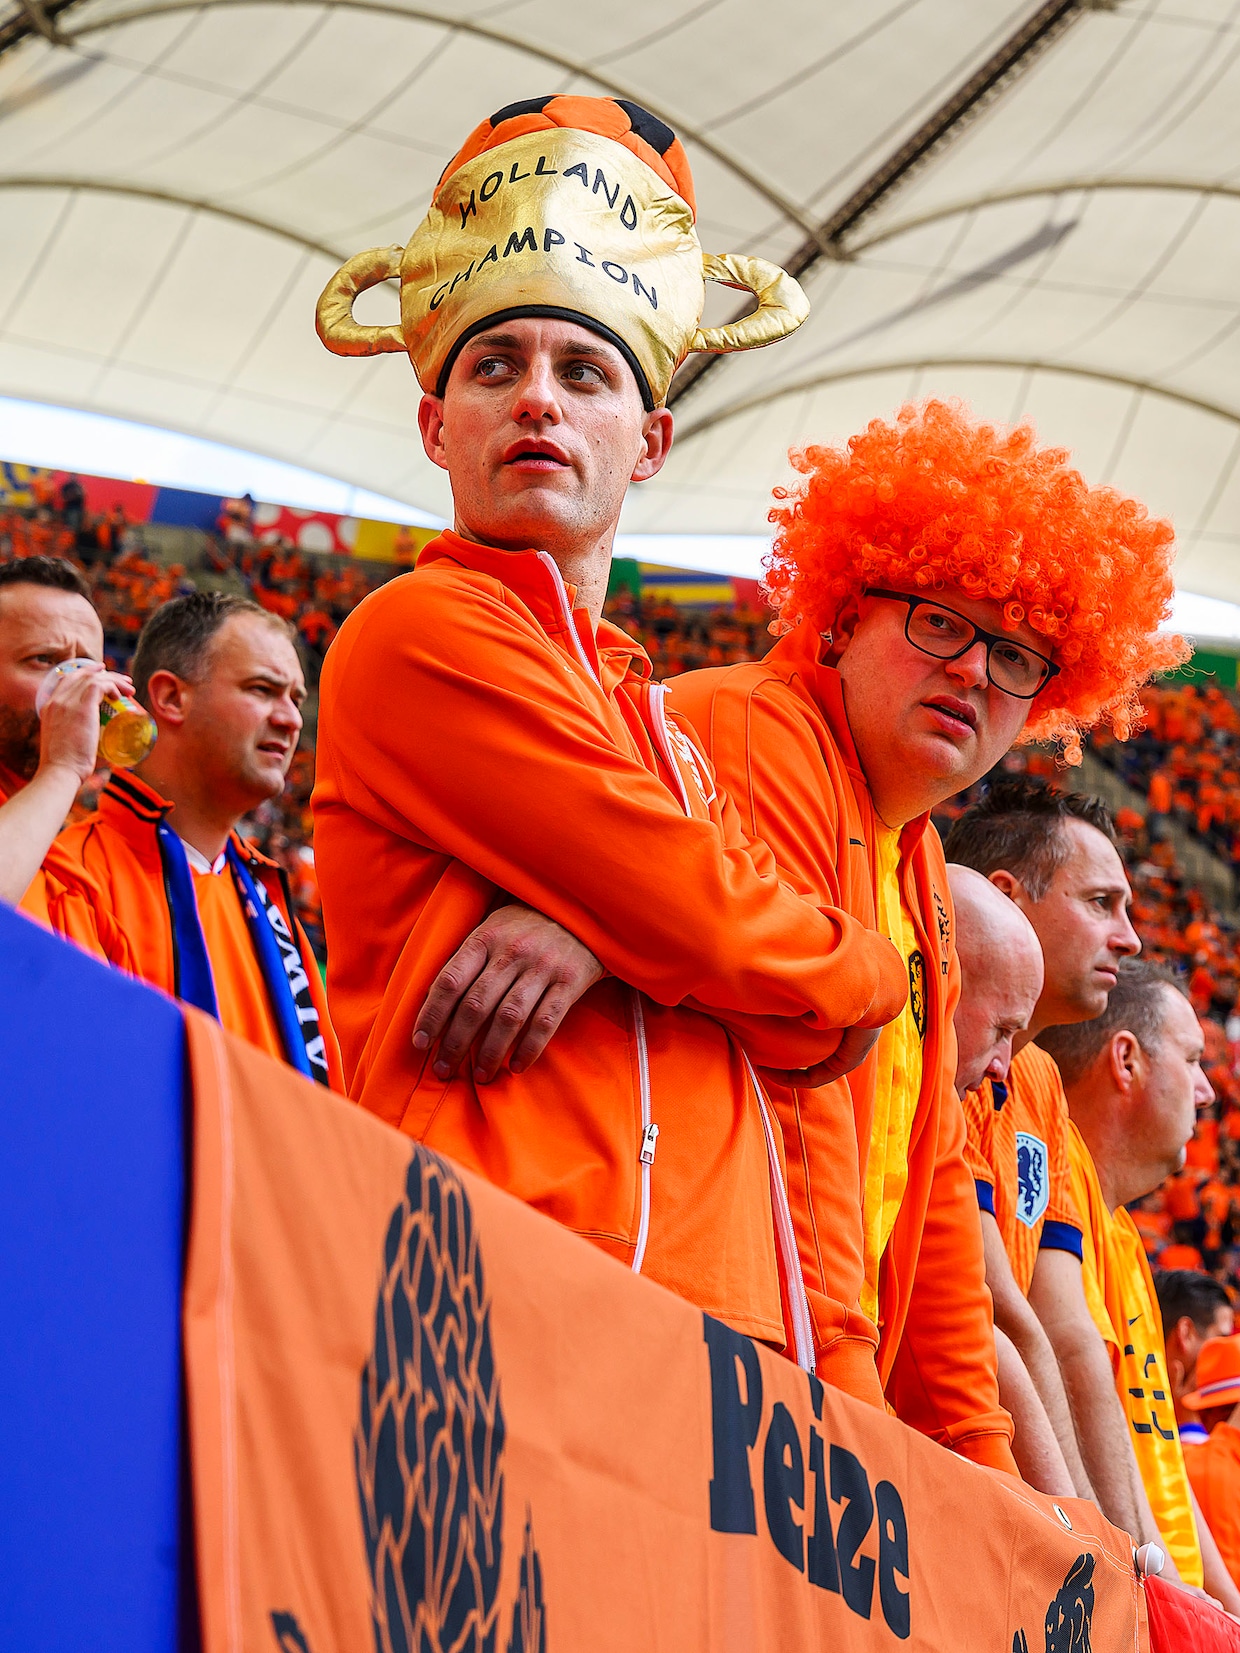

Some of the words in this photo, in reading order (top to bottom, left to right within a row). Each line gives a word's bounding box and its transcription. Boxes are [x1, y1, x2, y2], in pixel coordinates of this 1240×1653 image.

[458, 155, 638, 231] HOLLAND
[428, 227, 659, 311] CHAMPION
[702, 1311, 911, 1640] Peize
